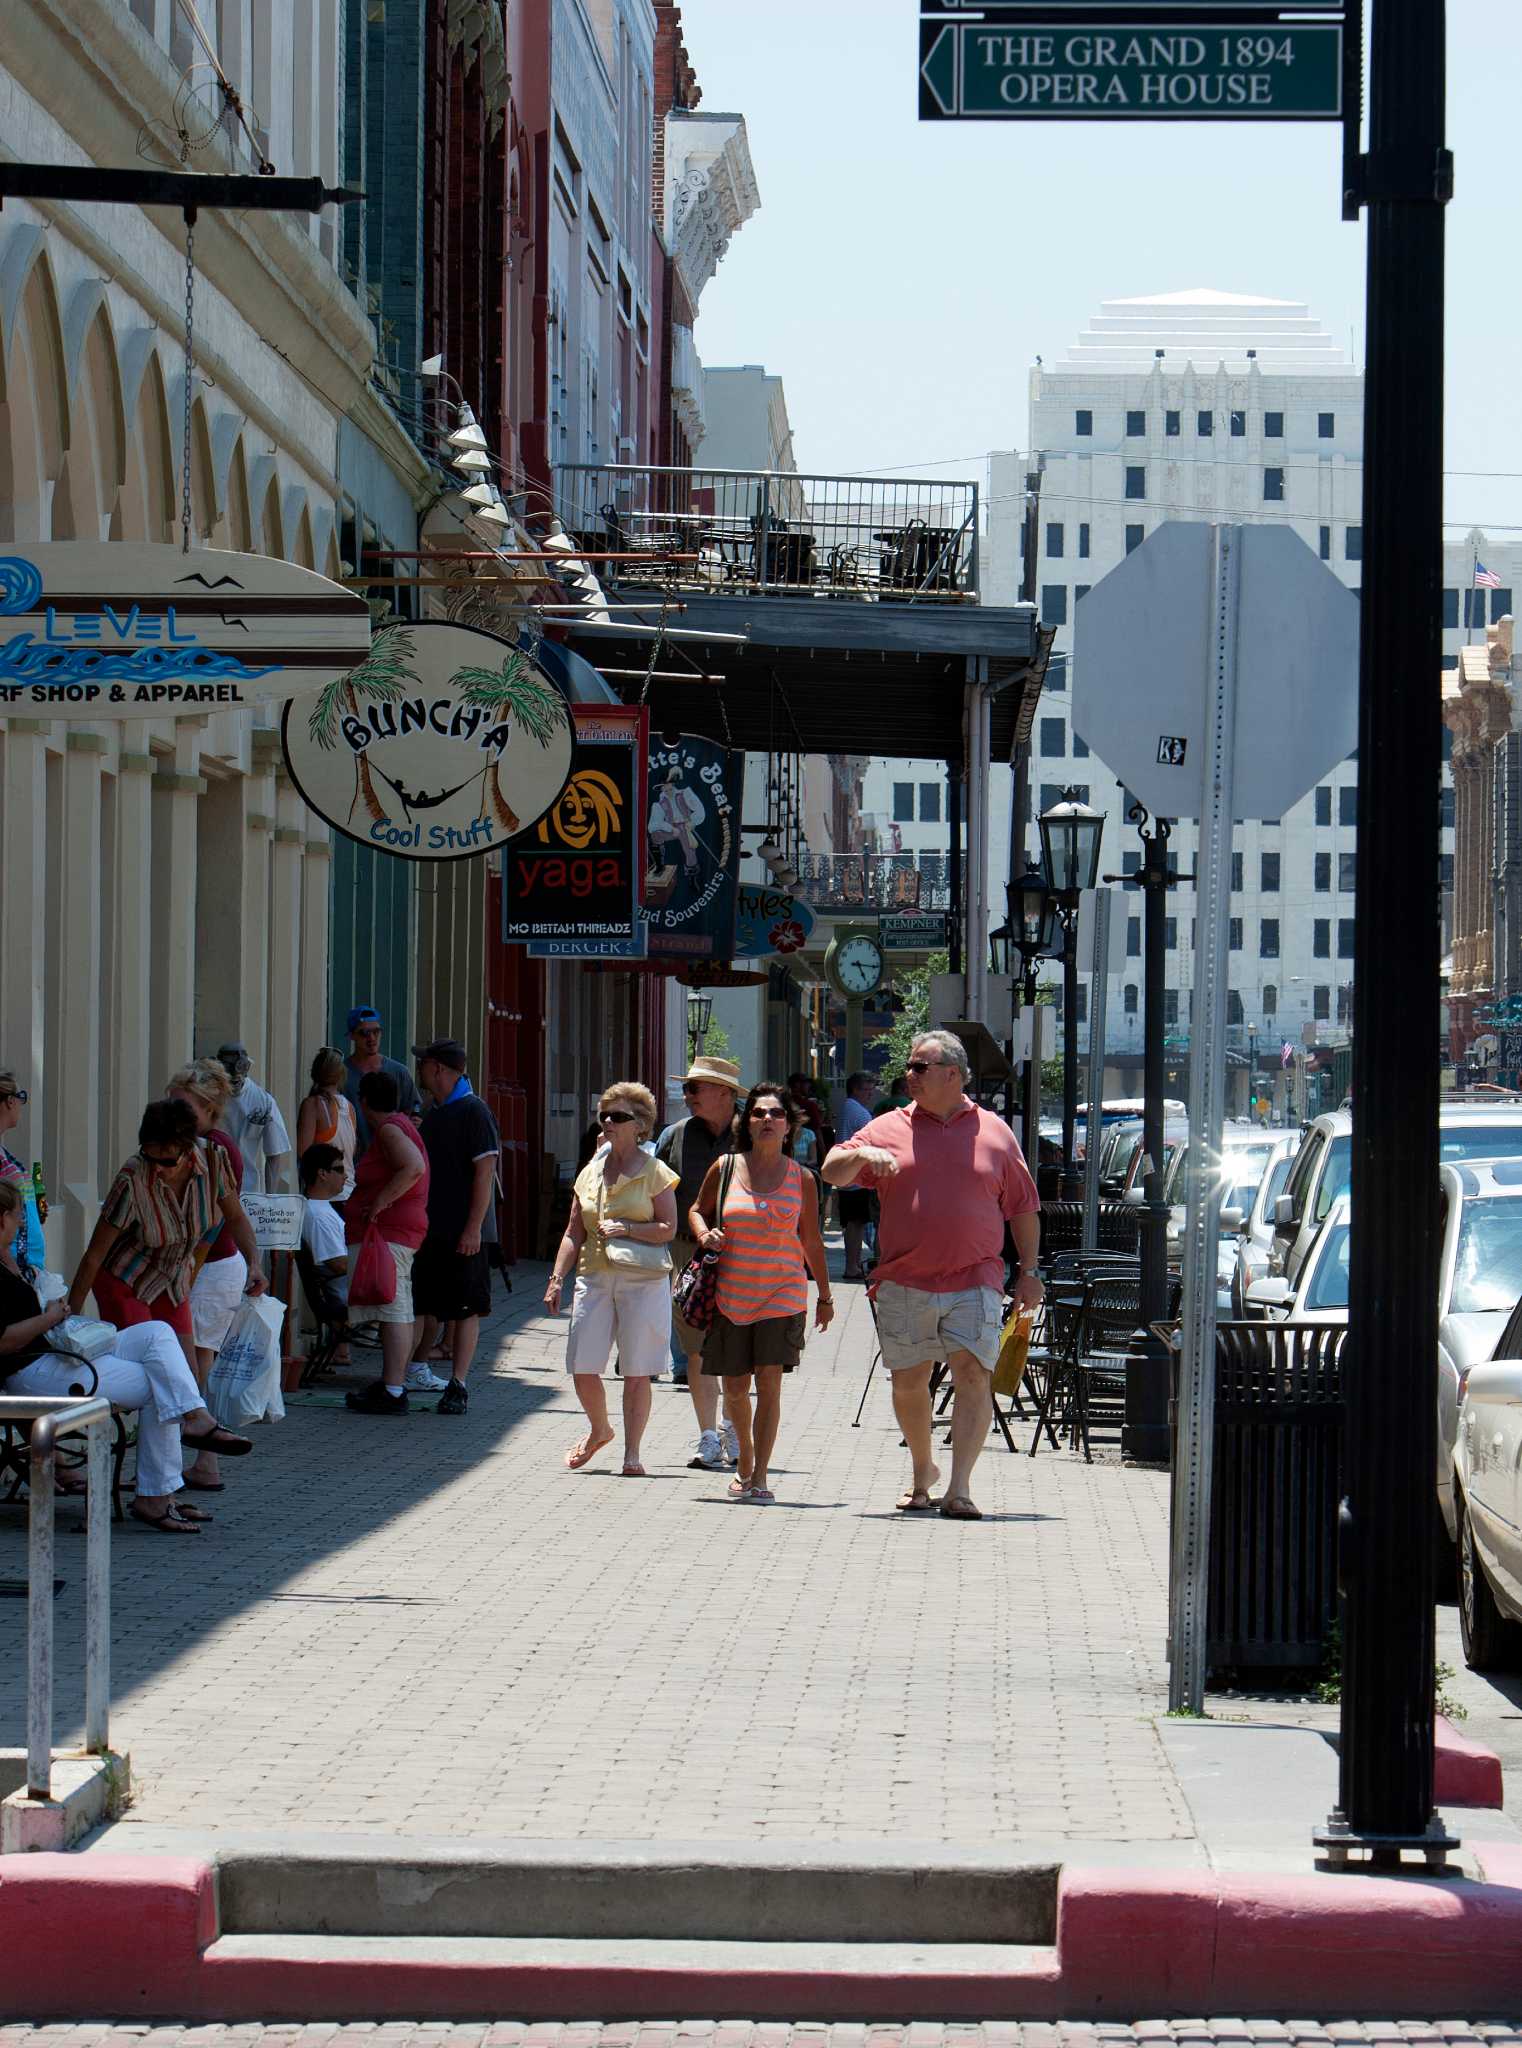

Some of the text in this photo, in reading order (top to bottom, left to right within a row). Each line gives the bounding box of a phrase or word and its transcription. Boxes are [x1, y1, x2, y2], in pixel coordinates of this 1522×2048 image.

[977, 36, 1295, 67] THE GRAND 1894
[1000, 74, 1273, 104] OPERA HOUSE
[45, 603, 197, 642] LEVEL
[31, 684, 101, 703] SHOP
[109, 684, 126, 702] &
[134, 684, 244, 703] APPAREL
[648, 749, 733, 816] tte's Beat
[370, 816, 494, 849] Cool Stuff
[517, 857, 621, 898] yaga
[665, 871, 724, 928] Souvenirs
[737, 887, 794, 920] tyles
[509, 922, 631, 934] MO BETTAH THREADZ
[885, 919, 940, 929] KEMPNER
